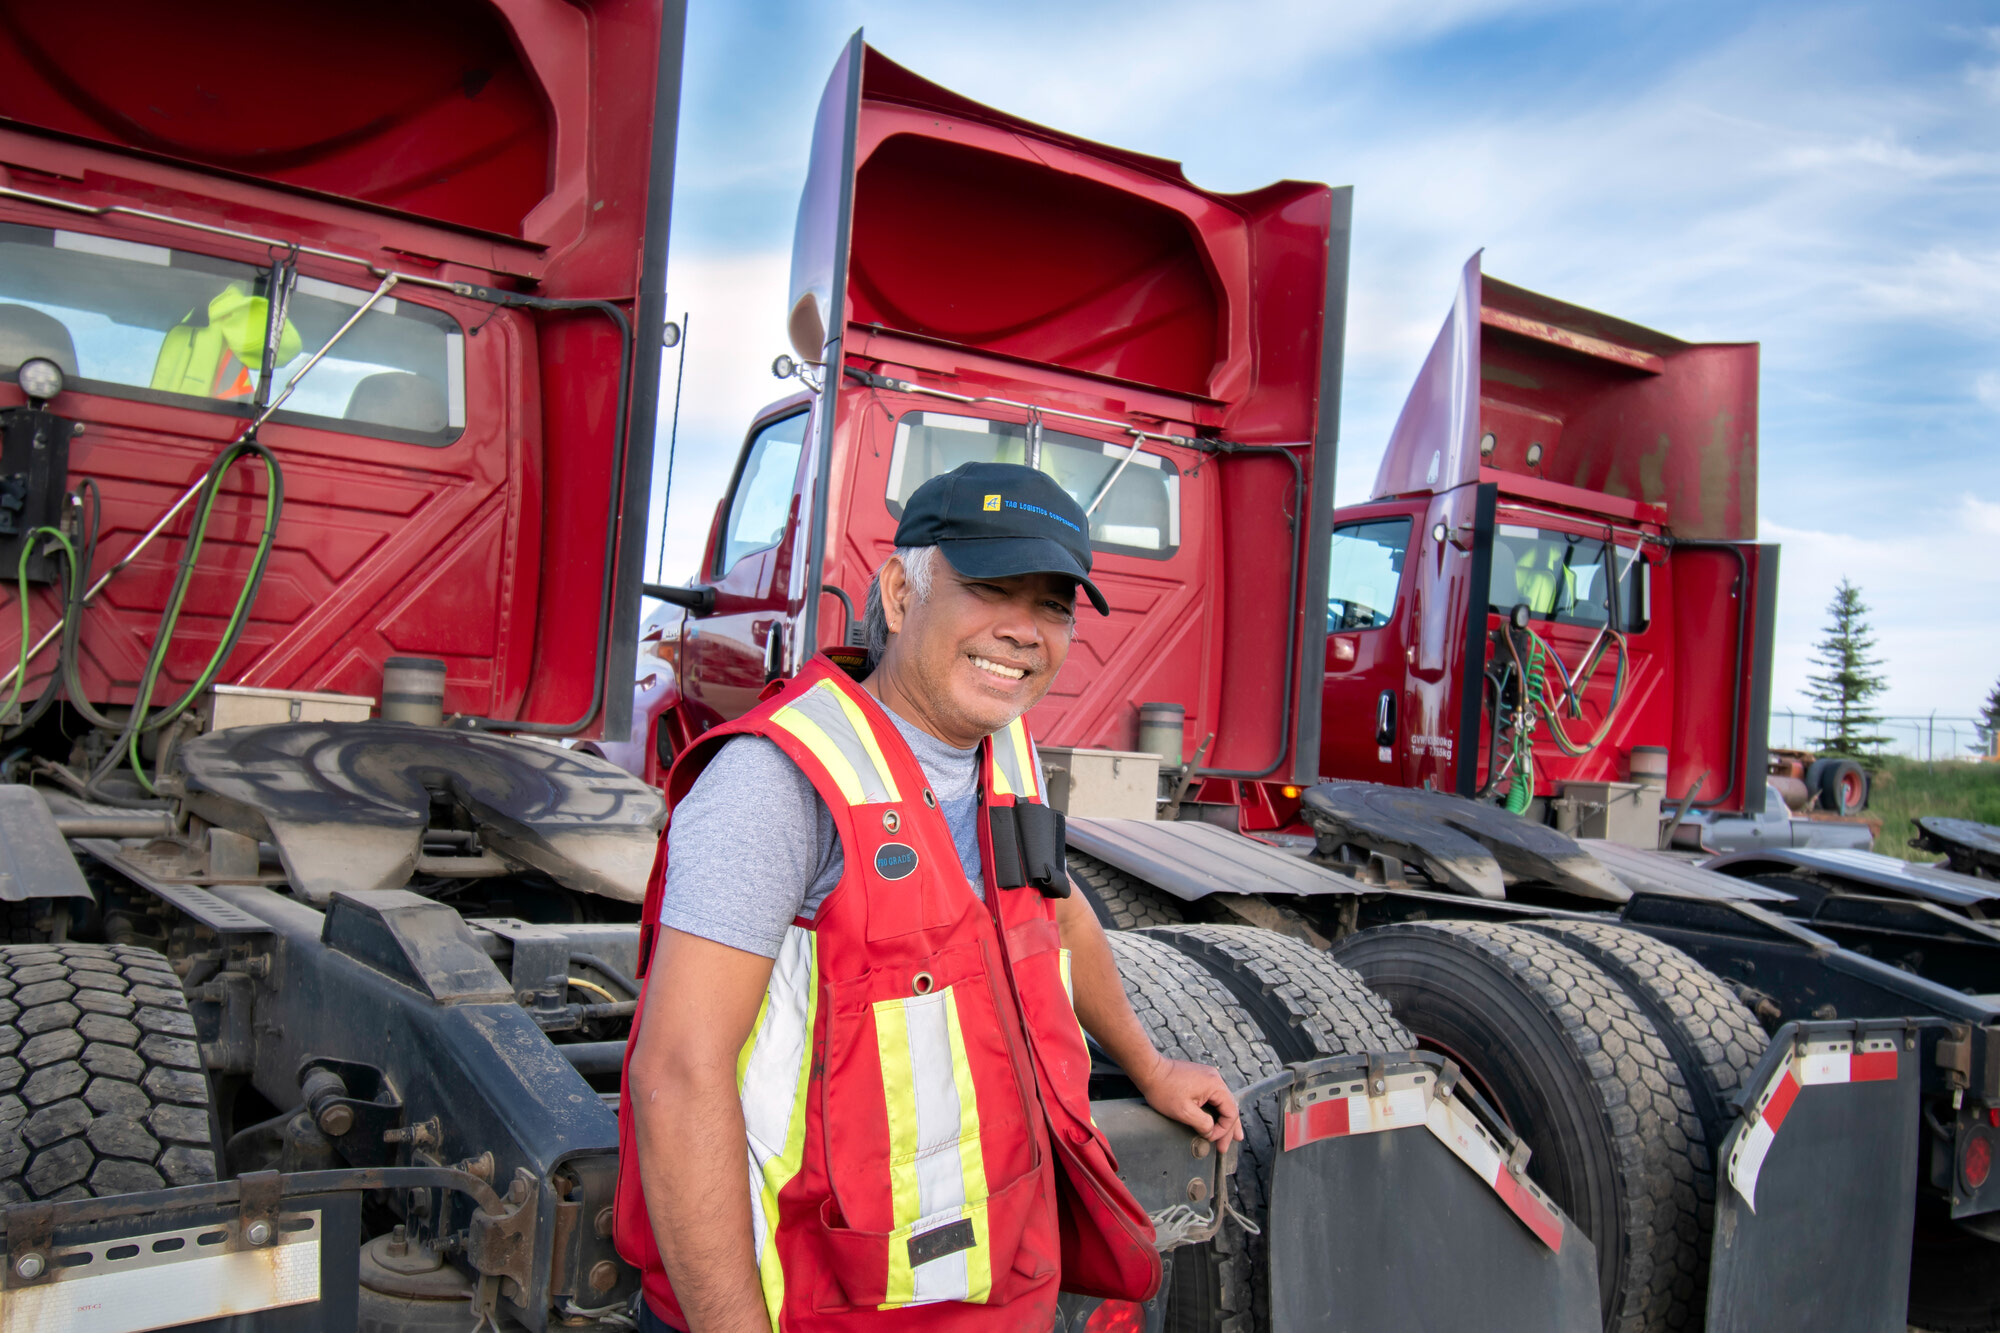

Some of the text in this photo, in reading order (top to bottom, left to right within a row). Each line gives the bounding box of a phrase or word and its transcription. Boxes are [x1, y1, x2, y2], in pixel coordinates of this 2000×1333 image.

[1005, 500, 1018, 508] TAG
[1019, 502, 1048, 516] LOGISTICS
[888, 853, 911, 866] GRADE
